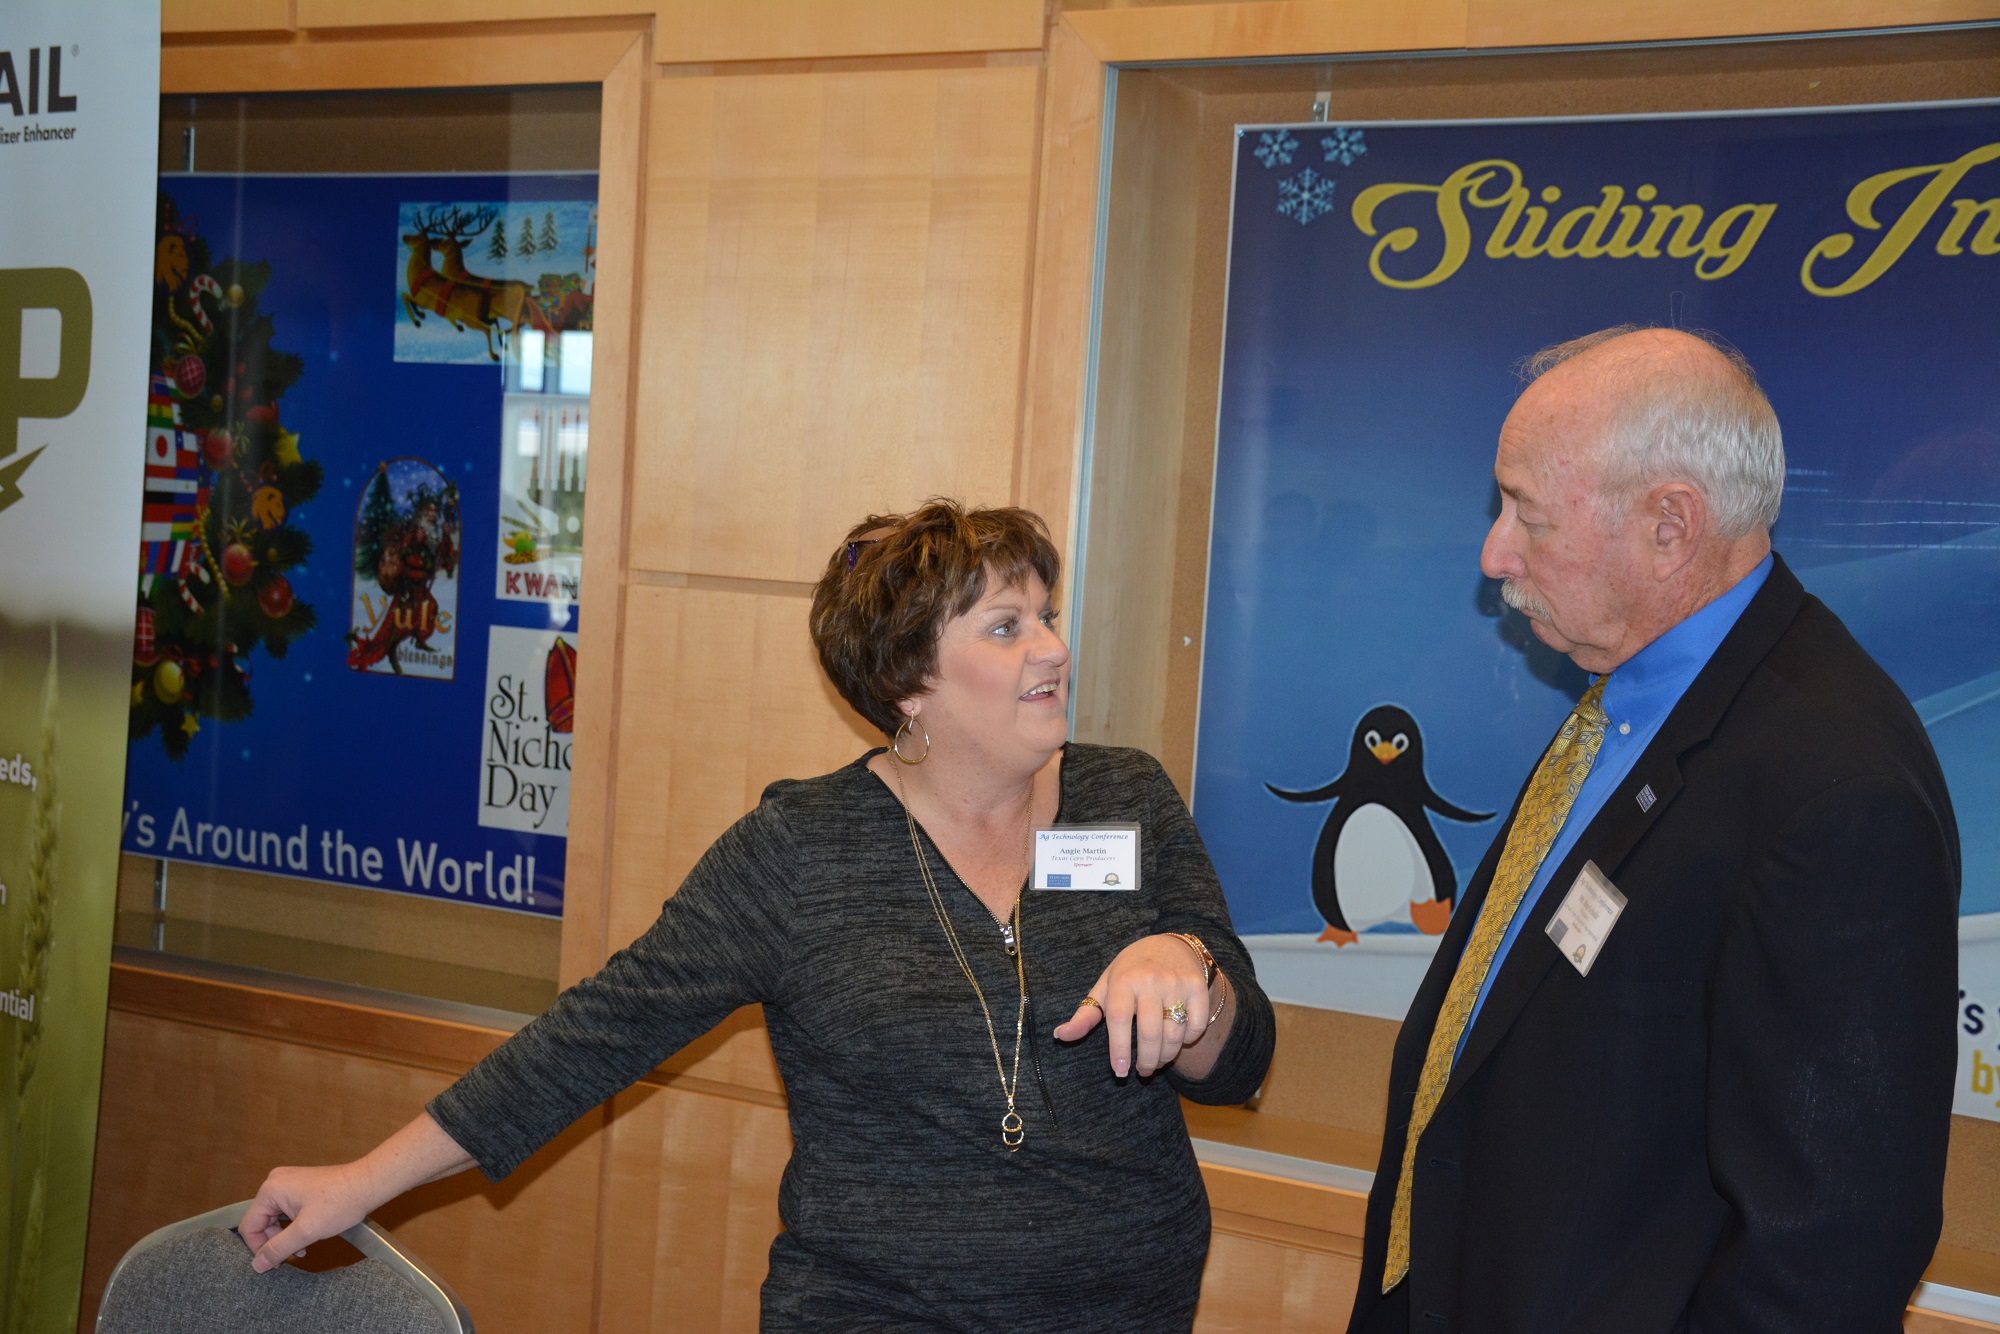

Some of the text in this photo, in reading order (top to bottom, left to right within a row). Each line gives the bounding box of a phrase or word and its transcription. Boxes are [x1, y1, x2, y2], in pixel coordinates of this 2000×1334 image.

[24, 123, 76, 142] Enhancer
[1351, 159, 1777, 289] Sliding
[506, 571, 578, 600] KWAN
[361, 593, 451, 634] Yule
[489, 674, 539, 723] St.
[0, 753, 37, 792] eds,
[485, 763, 558, 829] Day
[166, 807, 307, 870] Around
[321, 829, 383, 882] the
[397, 837, 536, 905] World!
[1040, 833, 1129, 841] Ag Technology Conference
[0, 989, 34, 1022] ntial
